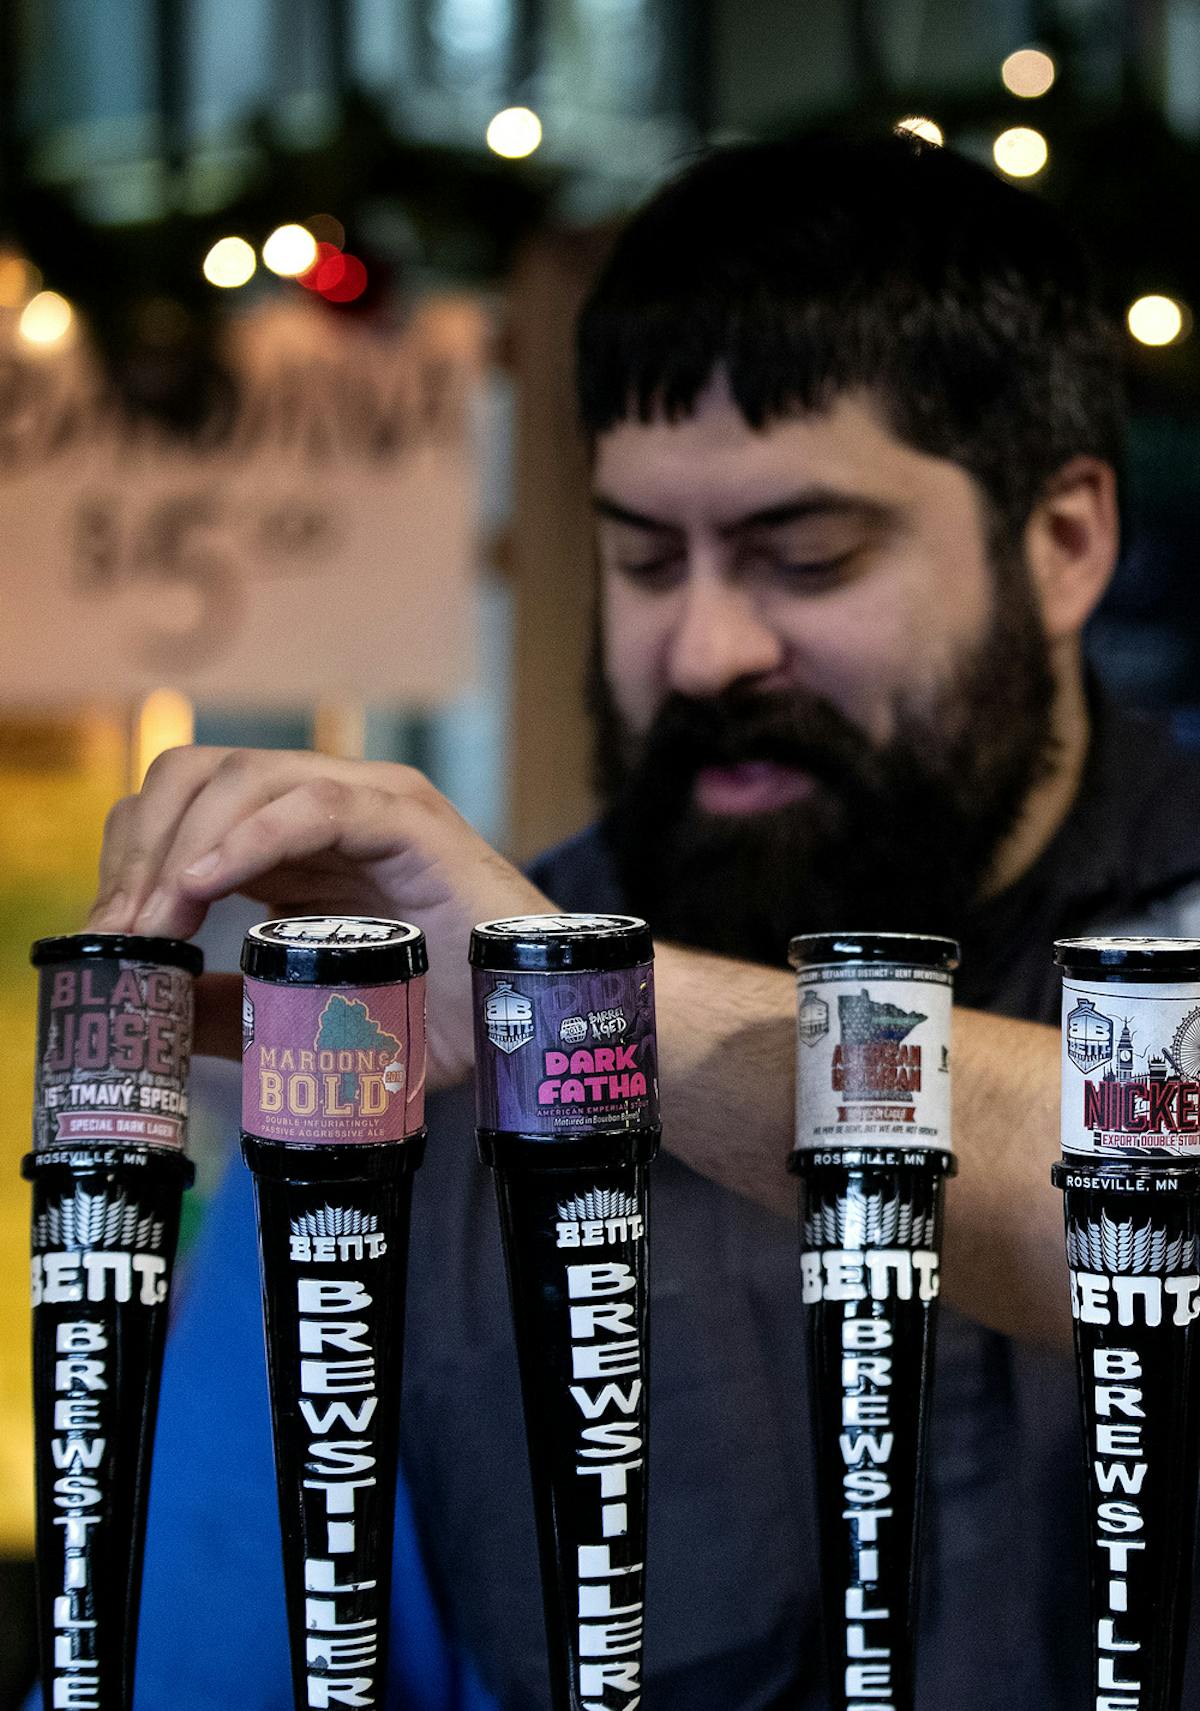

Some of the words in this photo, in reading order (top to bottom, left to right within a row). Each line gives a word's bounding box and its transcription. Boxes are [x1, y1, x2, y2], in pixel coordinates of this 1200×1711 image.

[592, 1017, 627, 1041] AGED
[545, 1044, 639, 1076] DARK
[69, 1079, 134, 1105] TMAVÝ
[259, 1069, 389, 1117] BOLD
[538, 1072, 647, 1104] FATHA
[266, 1116, 299, 1126] DOUBLE
[304, 1118, 380, 1128] INFURIATINGLY
[537, 1107, 584, 1117] AMERICAN
[587, 1102, 628, 1114] EMPERIAL
[554, 1117, 584, 1127] Matured
[585, 1116, 592, 1124] in
[593, 1114, 620, 1124] Bourbon
[70, 1119, 113, 1132] SPECIAL
[116, 1120, 145, 1133] DARK
[261, 1125, 294, 1136] PASSIVE
[298, 1129, 363, 1138] AGGRESSIVE
[367, 1129, 385, 1137] ALE
[1102, 1134, 1137, 1145] EXPORT
[1141, 1135, 1176, 1146] DOUBLE
[123, 1153, 148, 1166] MN
[904, 1153, 925, 1166] MN
[1155, 1178, 1178, 1191] MN
[556, 1214, 643, 1248] BENT
[290, 1232, 388, 1263] BENT
[800, 1249, 940, 1304] BENT
[297, 1278, 379, 1709] BREWSTILLER
[565, 1262, 643, 1711] BREWSTILLER
[839, 1318, 898, 1711] BREWSTILLE
